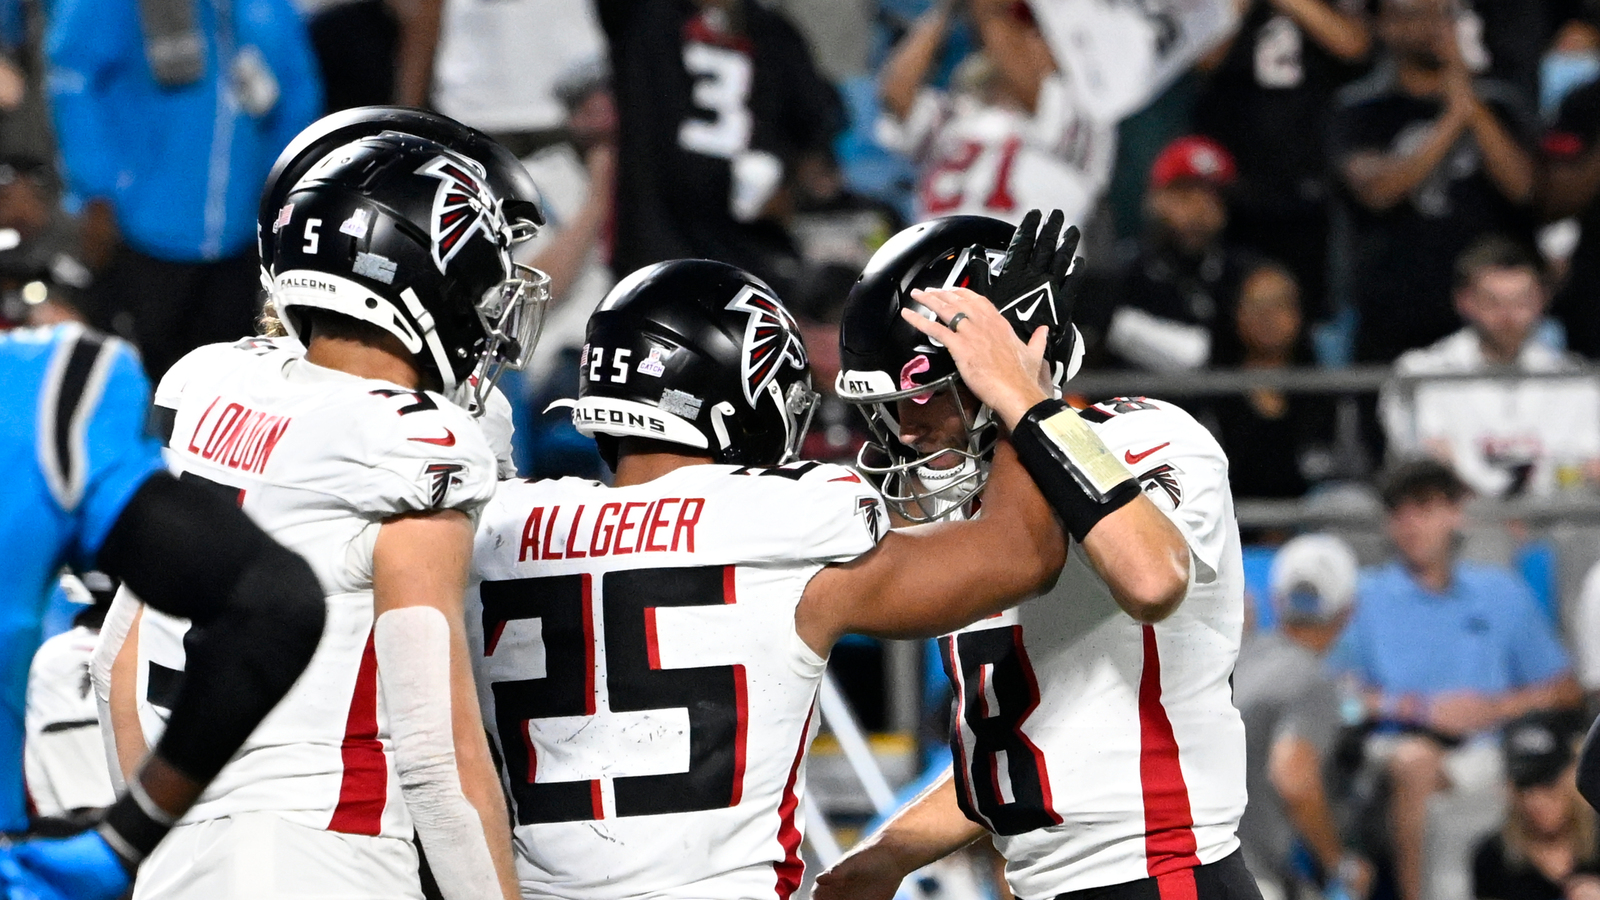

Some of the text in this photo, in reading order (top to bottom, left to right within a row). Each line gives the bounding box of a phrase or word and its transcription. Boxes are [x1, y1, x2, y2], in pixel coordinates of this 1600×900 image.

[678, 42, 753, 156] 3
[922, 138, 1022, 211] 21
[303, 219, 322, 254] 5
[281, 278, 336, 292] FALCONS
[590, 347, 631, 384] 25
[640, 362, 663, 373] CATCH
[849, 380, 874, 393] ATL
[188, 396, 292, 475] LONDON
[571, 408, 665, 433] FALCONS
[518, 497, 706, 562] ALLGEIER
[480, 564, 748, 825] 25
[937, 624, 1063, 837] 18
